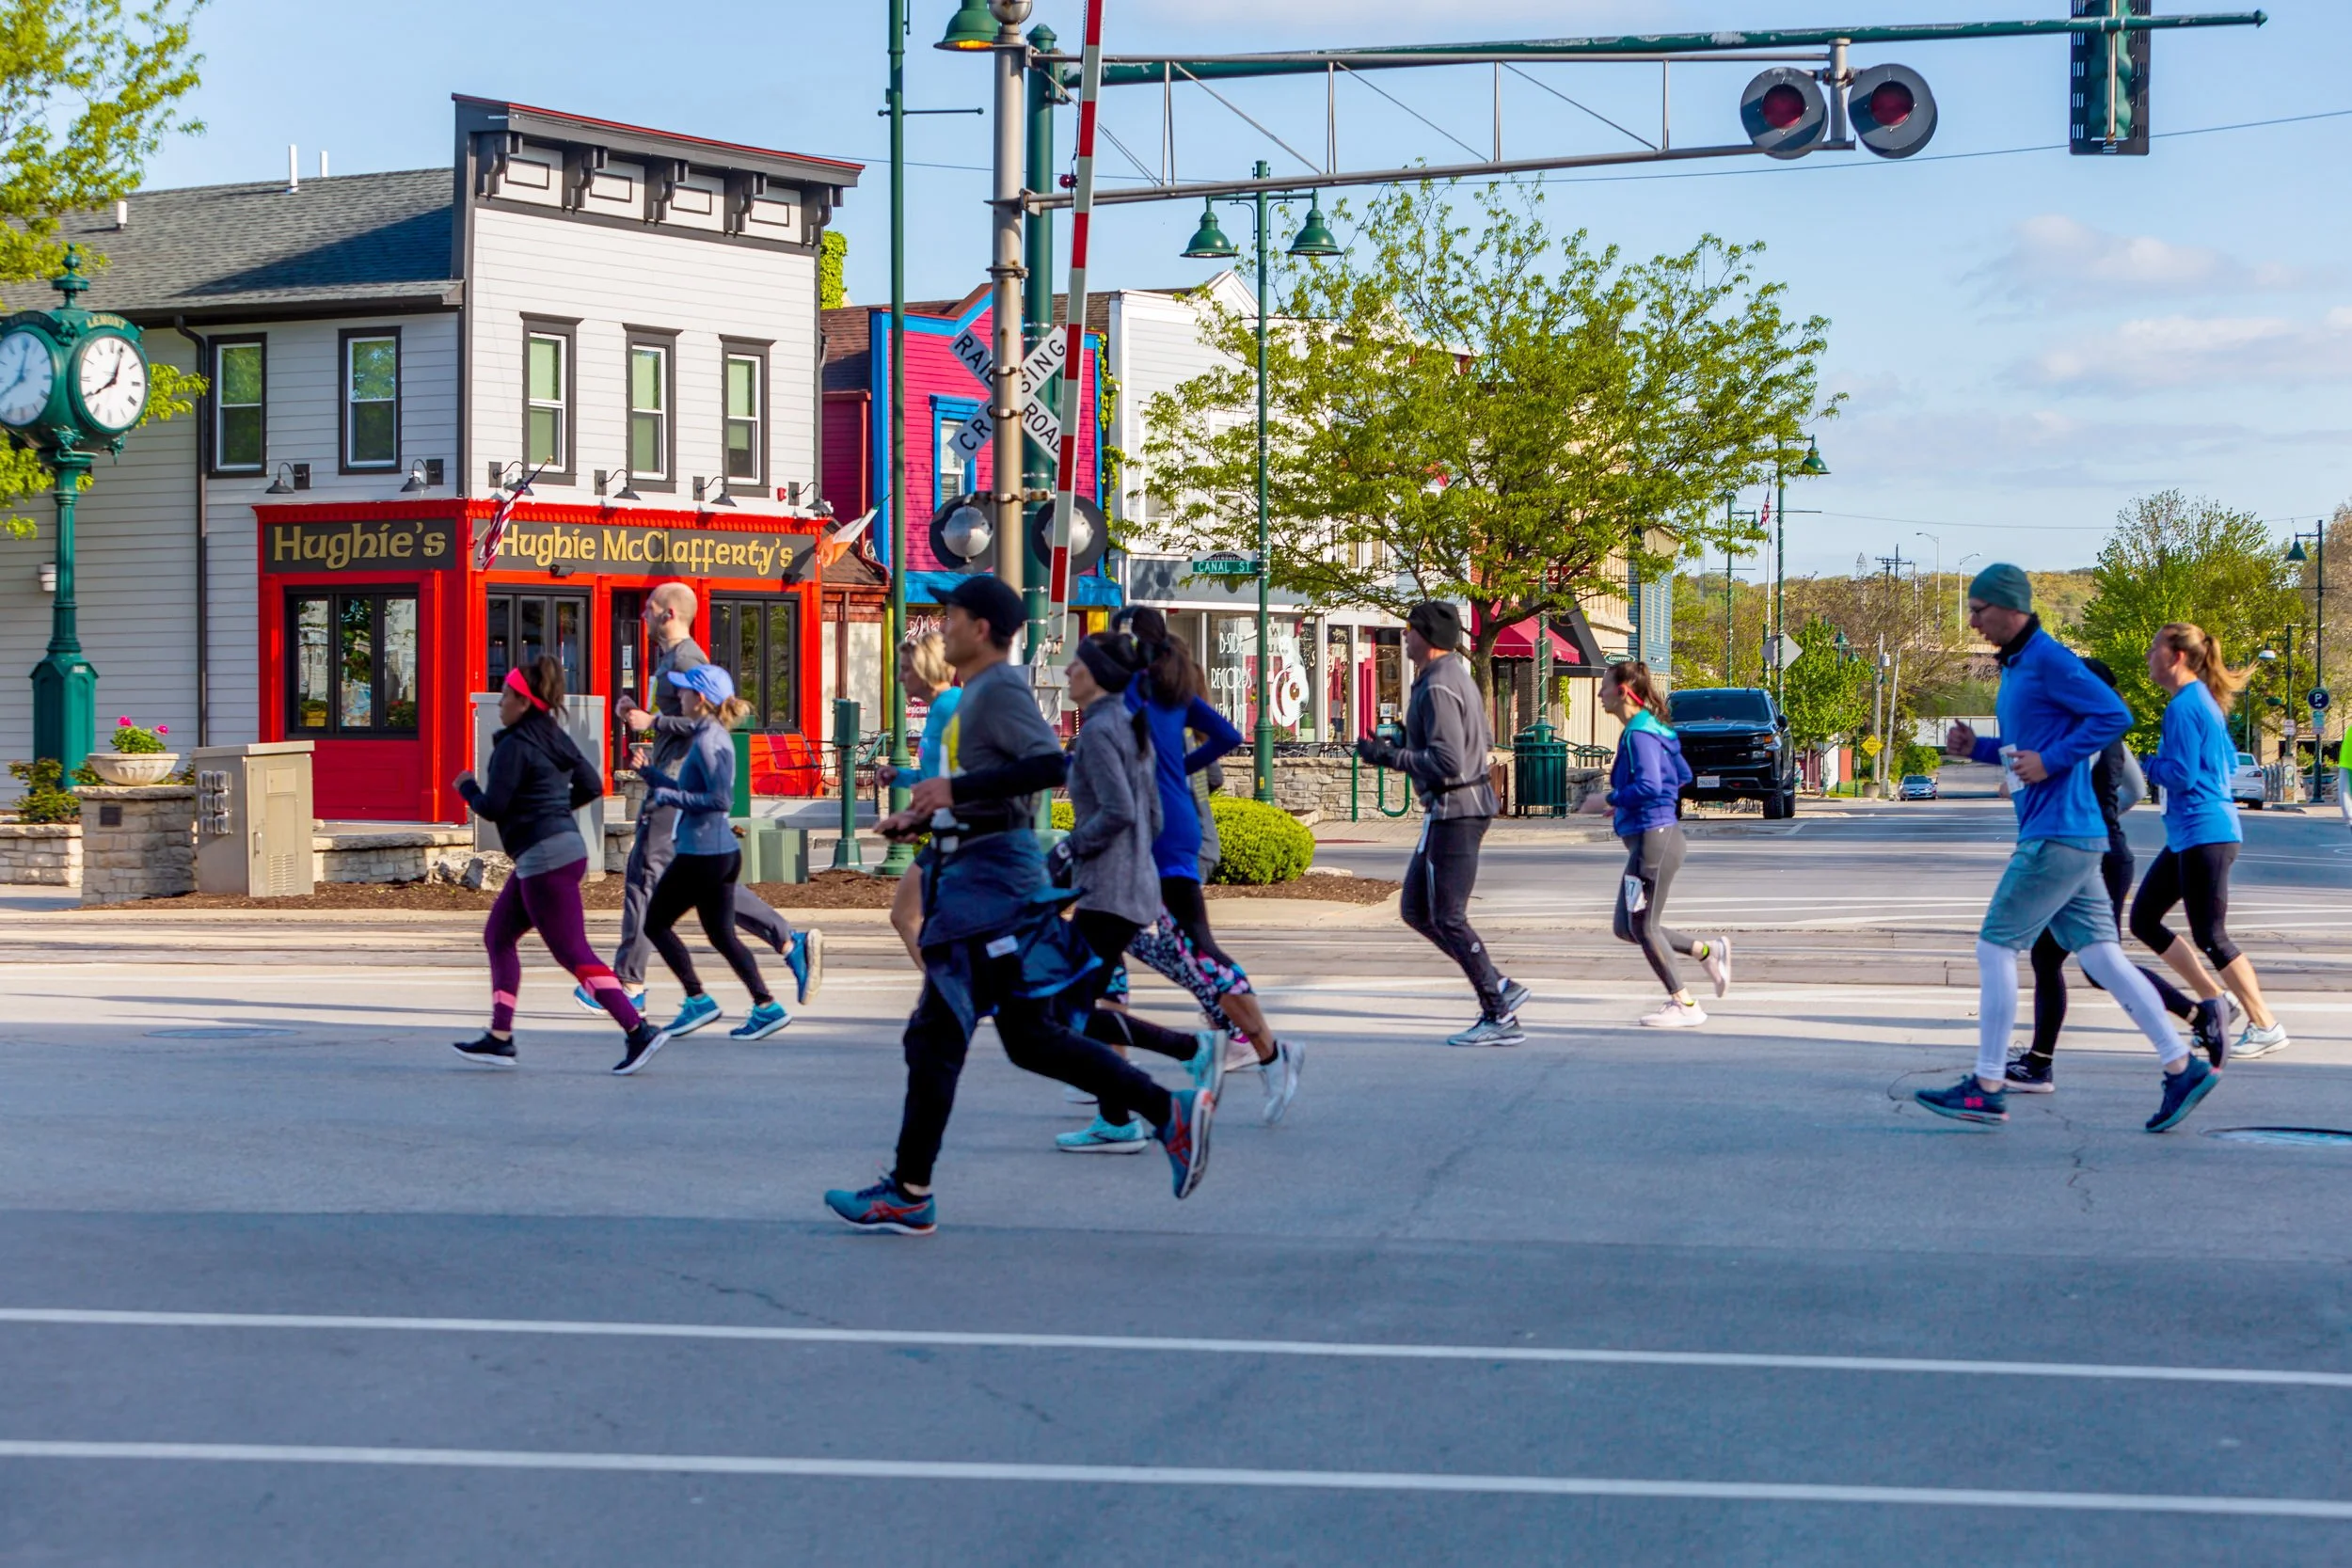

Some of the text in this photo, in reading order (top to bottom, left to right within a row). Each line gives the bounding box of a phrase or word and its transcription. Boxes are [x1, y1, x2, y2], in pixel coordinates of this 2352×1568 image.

[86, 314, 127, 330] LEMONT
[274, 522, 445, 570] Hughie's
[498, 524, 793, 576] Hughie McClafferty's
[1198, 562, 1250, 572] CANAL ST
[1219, 632, 1243, 654] B-SIDE
[1211, 666, 1252, 689] RECORDS
[2314, 693, 2323, 703] P
